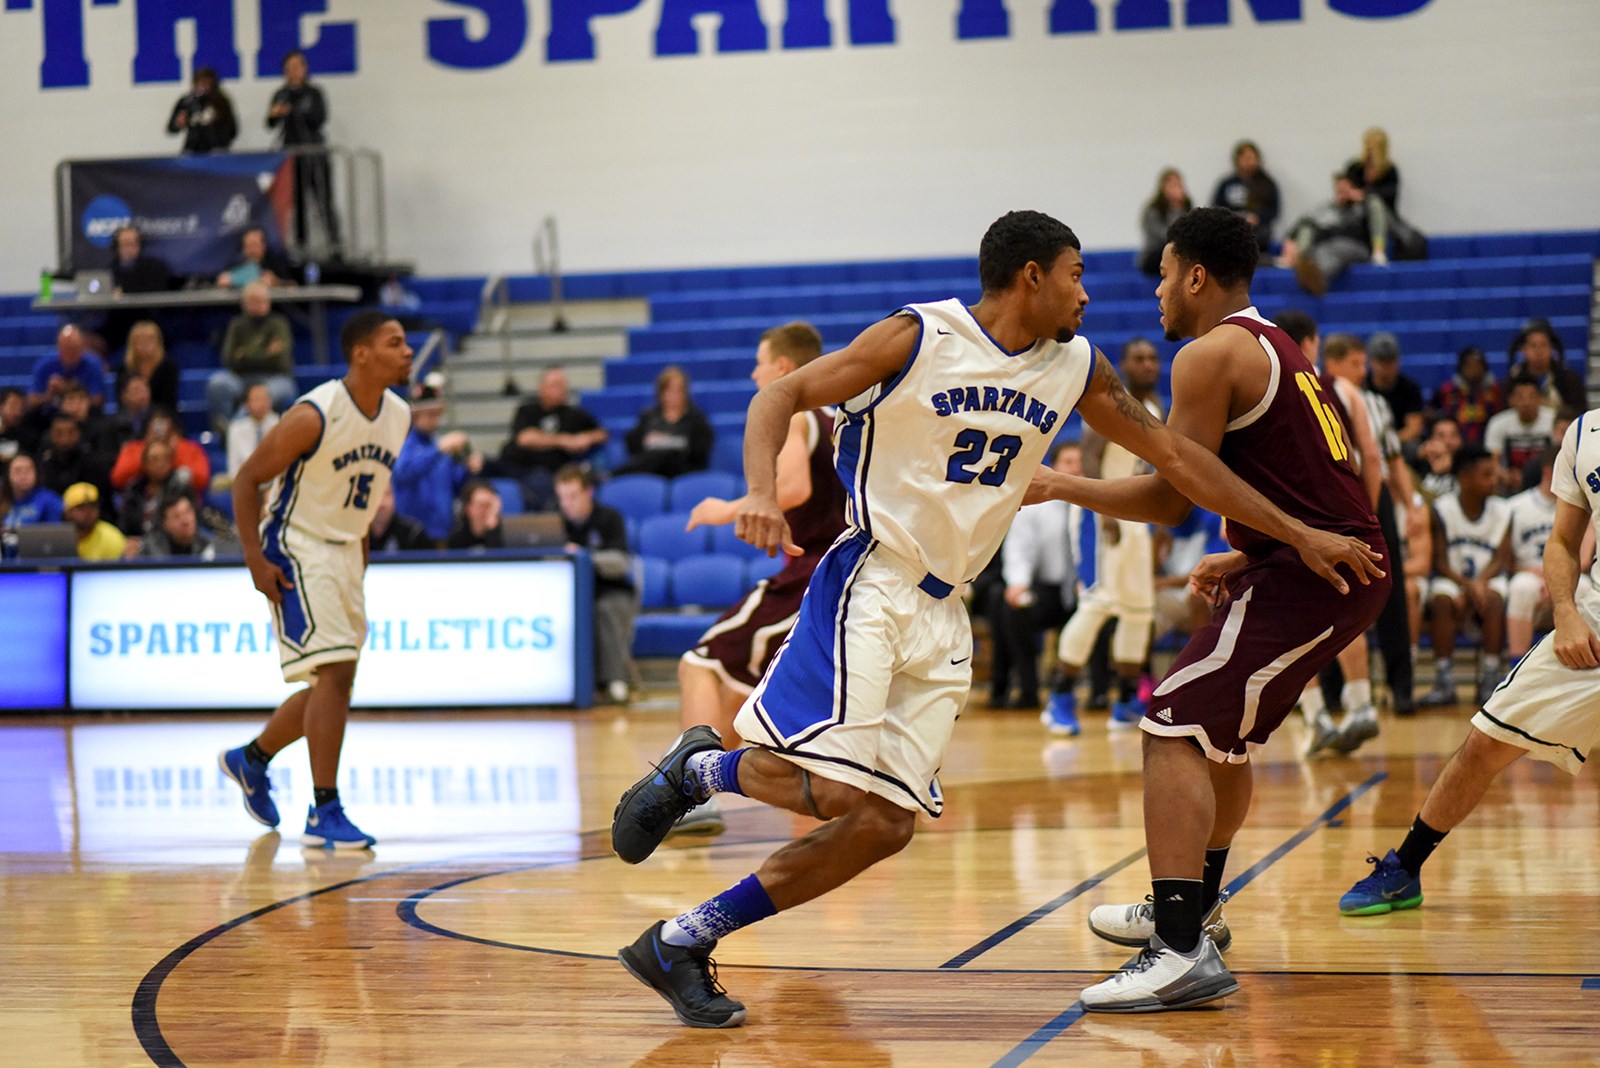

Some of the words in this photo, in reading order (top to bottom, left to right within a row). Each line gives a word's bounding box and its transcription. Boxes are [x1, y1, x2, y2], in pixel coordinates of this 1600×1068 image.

[931, 386, 1058, 434] SPARTANS
[945, 428, 1023, 487] 23
[343, 473, 375, 509] 15
[366, 615, 556, 650] HLETICS
